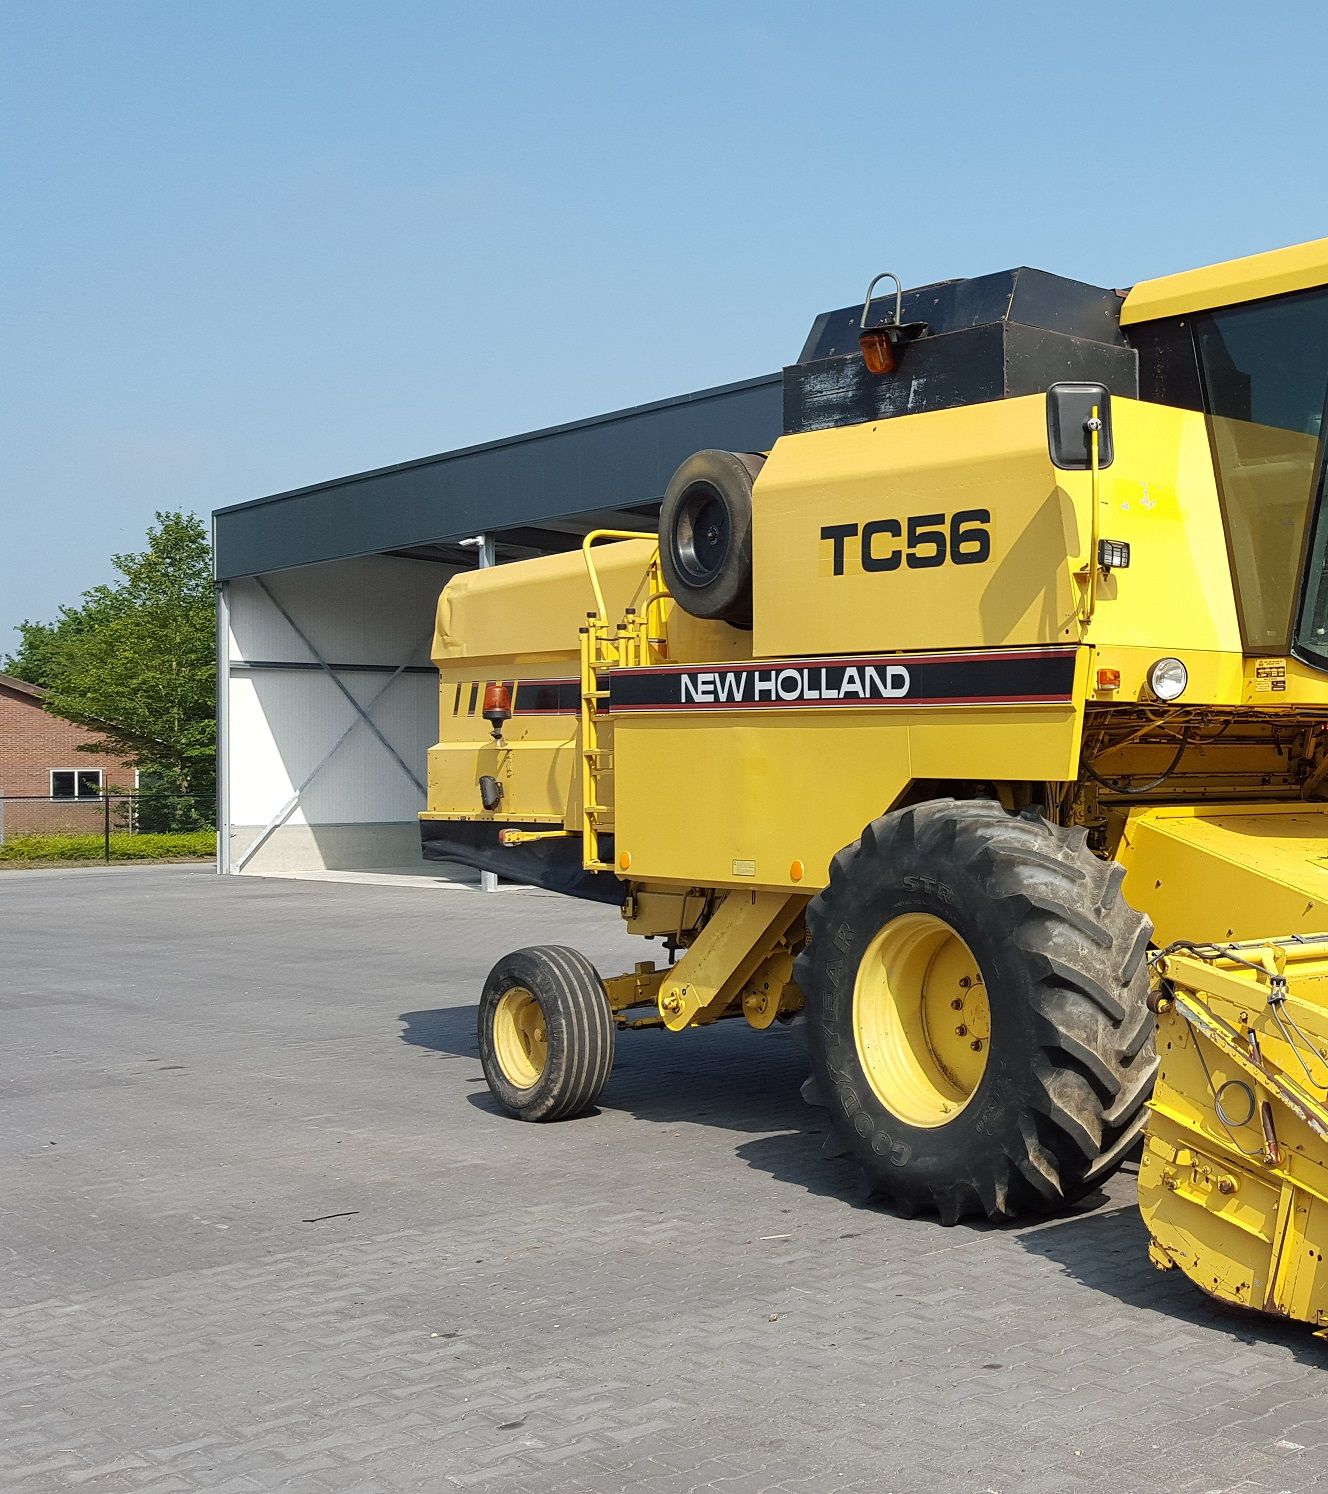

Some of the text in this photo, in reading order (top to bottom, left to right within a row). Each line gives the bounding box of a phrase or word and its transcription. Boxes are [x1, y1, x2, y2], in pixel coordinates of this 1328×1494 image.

[820, 508, 991, 576] TC56
[681, 665, 911, 703] NEW HOLLAND
